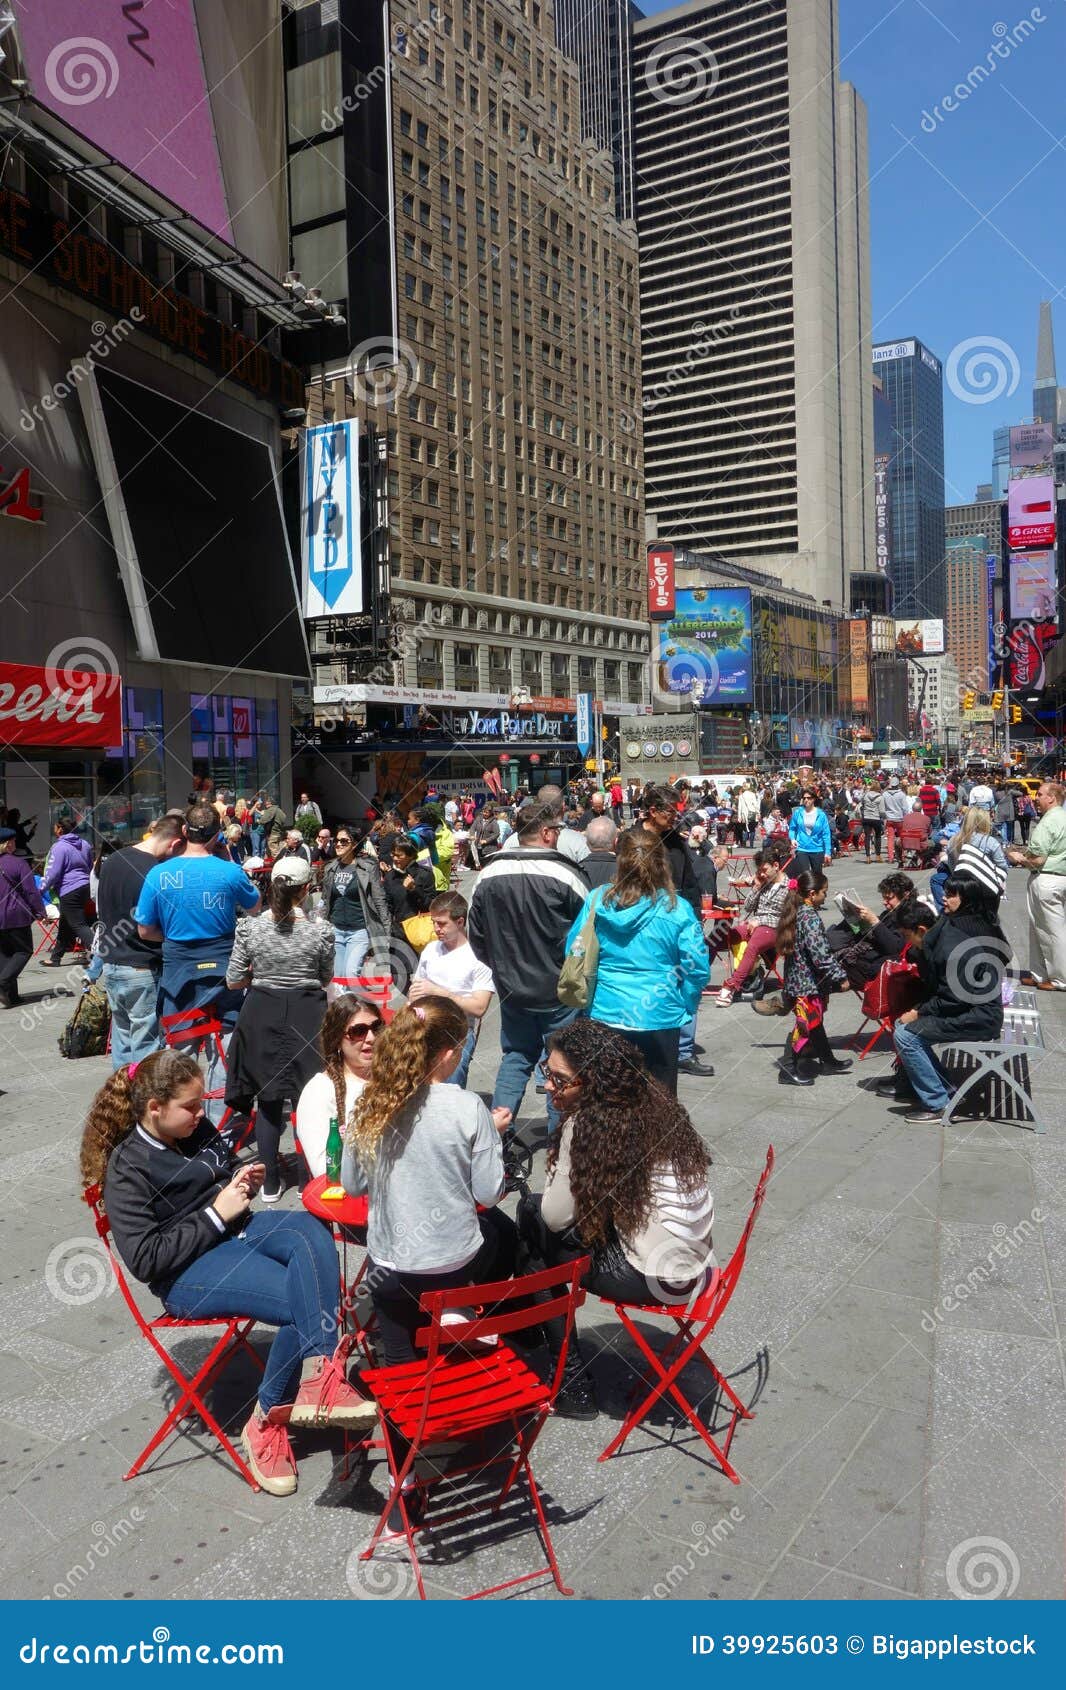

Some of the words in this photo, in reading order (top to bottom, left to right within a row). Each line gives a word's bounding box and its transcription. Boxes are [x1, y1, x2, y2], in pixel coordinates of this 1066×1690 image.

[321, 433, 339, 569] NYPD
[876, 472, 887, 528] TIMES
[1022, 525, 1051, 536] GREE
[695, 631, 718, 639] 2014
[578, 695, 587, 743] NYPD
